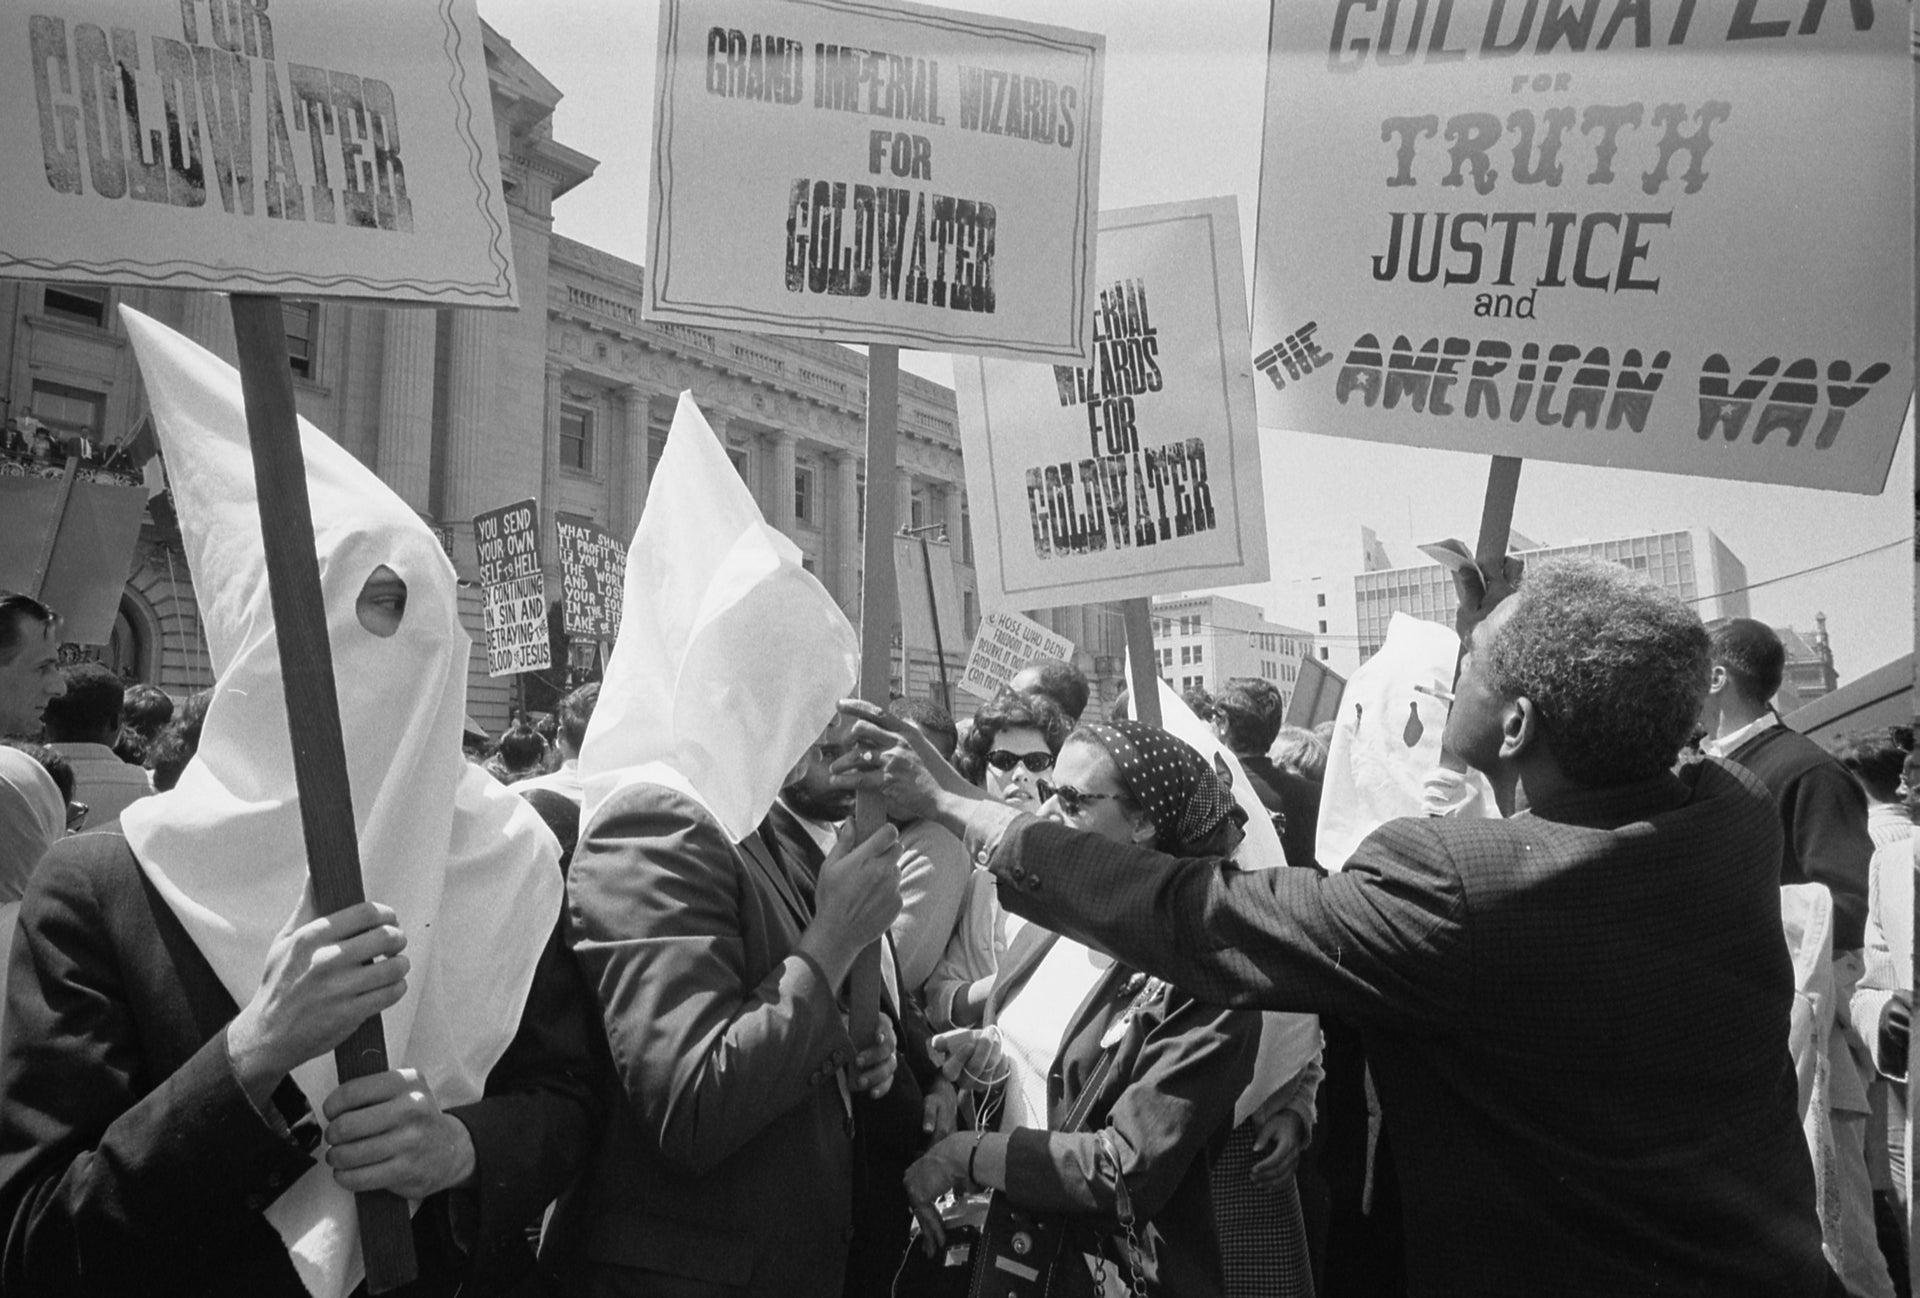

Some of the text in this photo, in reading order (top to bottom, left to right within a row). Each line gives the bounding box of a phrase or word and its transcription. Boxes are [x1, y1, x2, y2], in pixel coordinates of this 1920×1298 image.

[706, 26, 1077, 148] GRAND IMPERIAL WIZARDS
[1511, 72, 1573, 94] FOR
[29, 15, 414, 234] GOLDWATER
[868, 129, 932, 180] FOR
[1380, 101, 1732, 195] TRUTH
[784, 177, 997, 314] GOLDWATER
[1371, 208, 1674, 294] JUSTICE
[1474, 288, 1537, 320] and
[1253, 320, 1892, 450] THE AMERICAN WAY
[1087, 396, 1140, 458] FOR
[1025, 437, 1217, 560] GOLDWATER
[478, 508, 531, 541] YOU SEND
[557, 521, 627, 555] WHAT SHALL
[478, 529, 535, 564] YOUR OWN
[559, 534, 571, 549] IT
[577, 539, 609, 560] PROFIT
[578, 552, 598, 568] YOU
[480, 551, 541, 586] SELF TO HELL
[561, 560, 585, 579] THE
[493, 575, 543, 605] CONTINUING
[564, 574, 624, 600] AND LOSE
[565, 586, 595, 606] YOUR
[486, 597, 543, 628] IN SIN AND
[565, 600, 581, 615] IN
[565, 612, 595, 631] LAKE
[486, 622, 534, 651] BETRAYING
[1022, 626, 1043, 647] WHO
[1022, 644, 1033, 658] TO
[489, 649, 513, 673] BLOOD
[520, 642, 549, 667] JESUS
